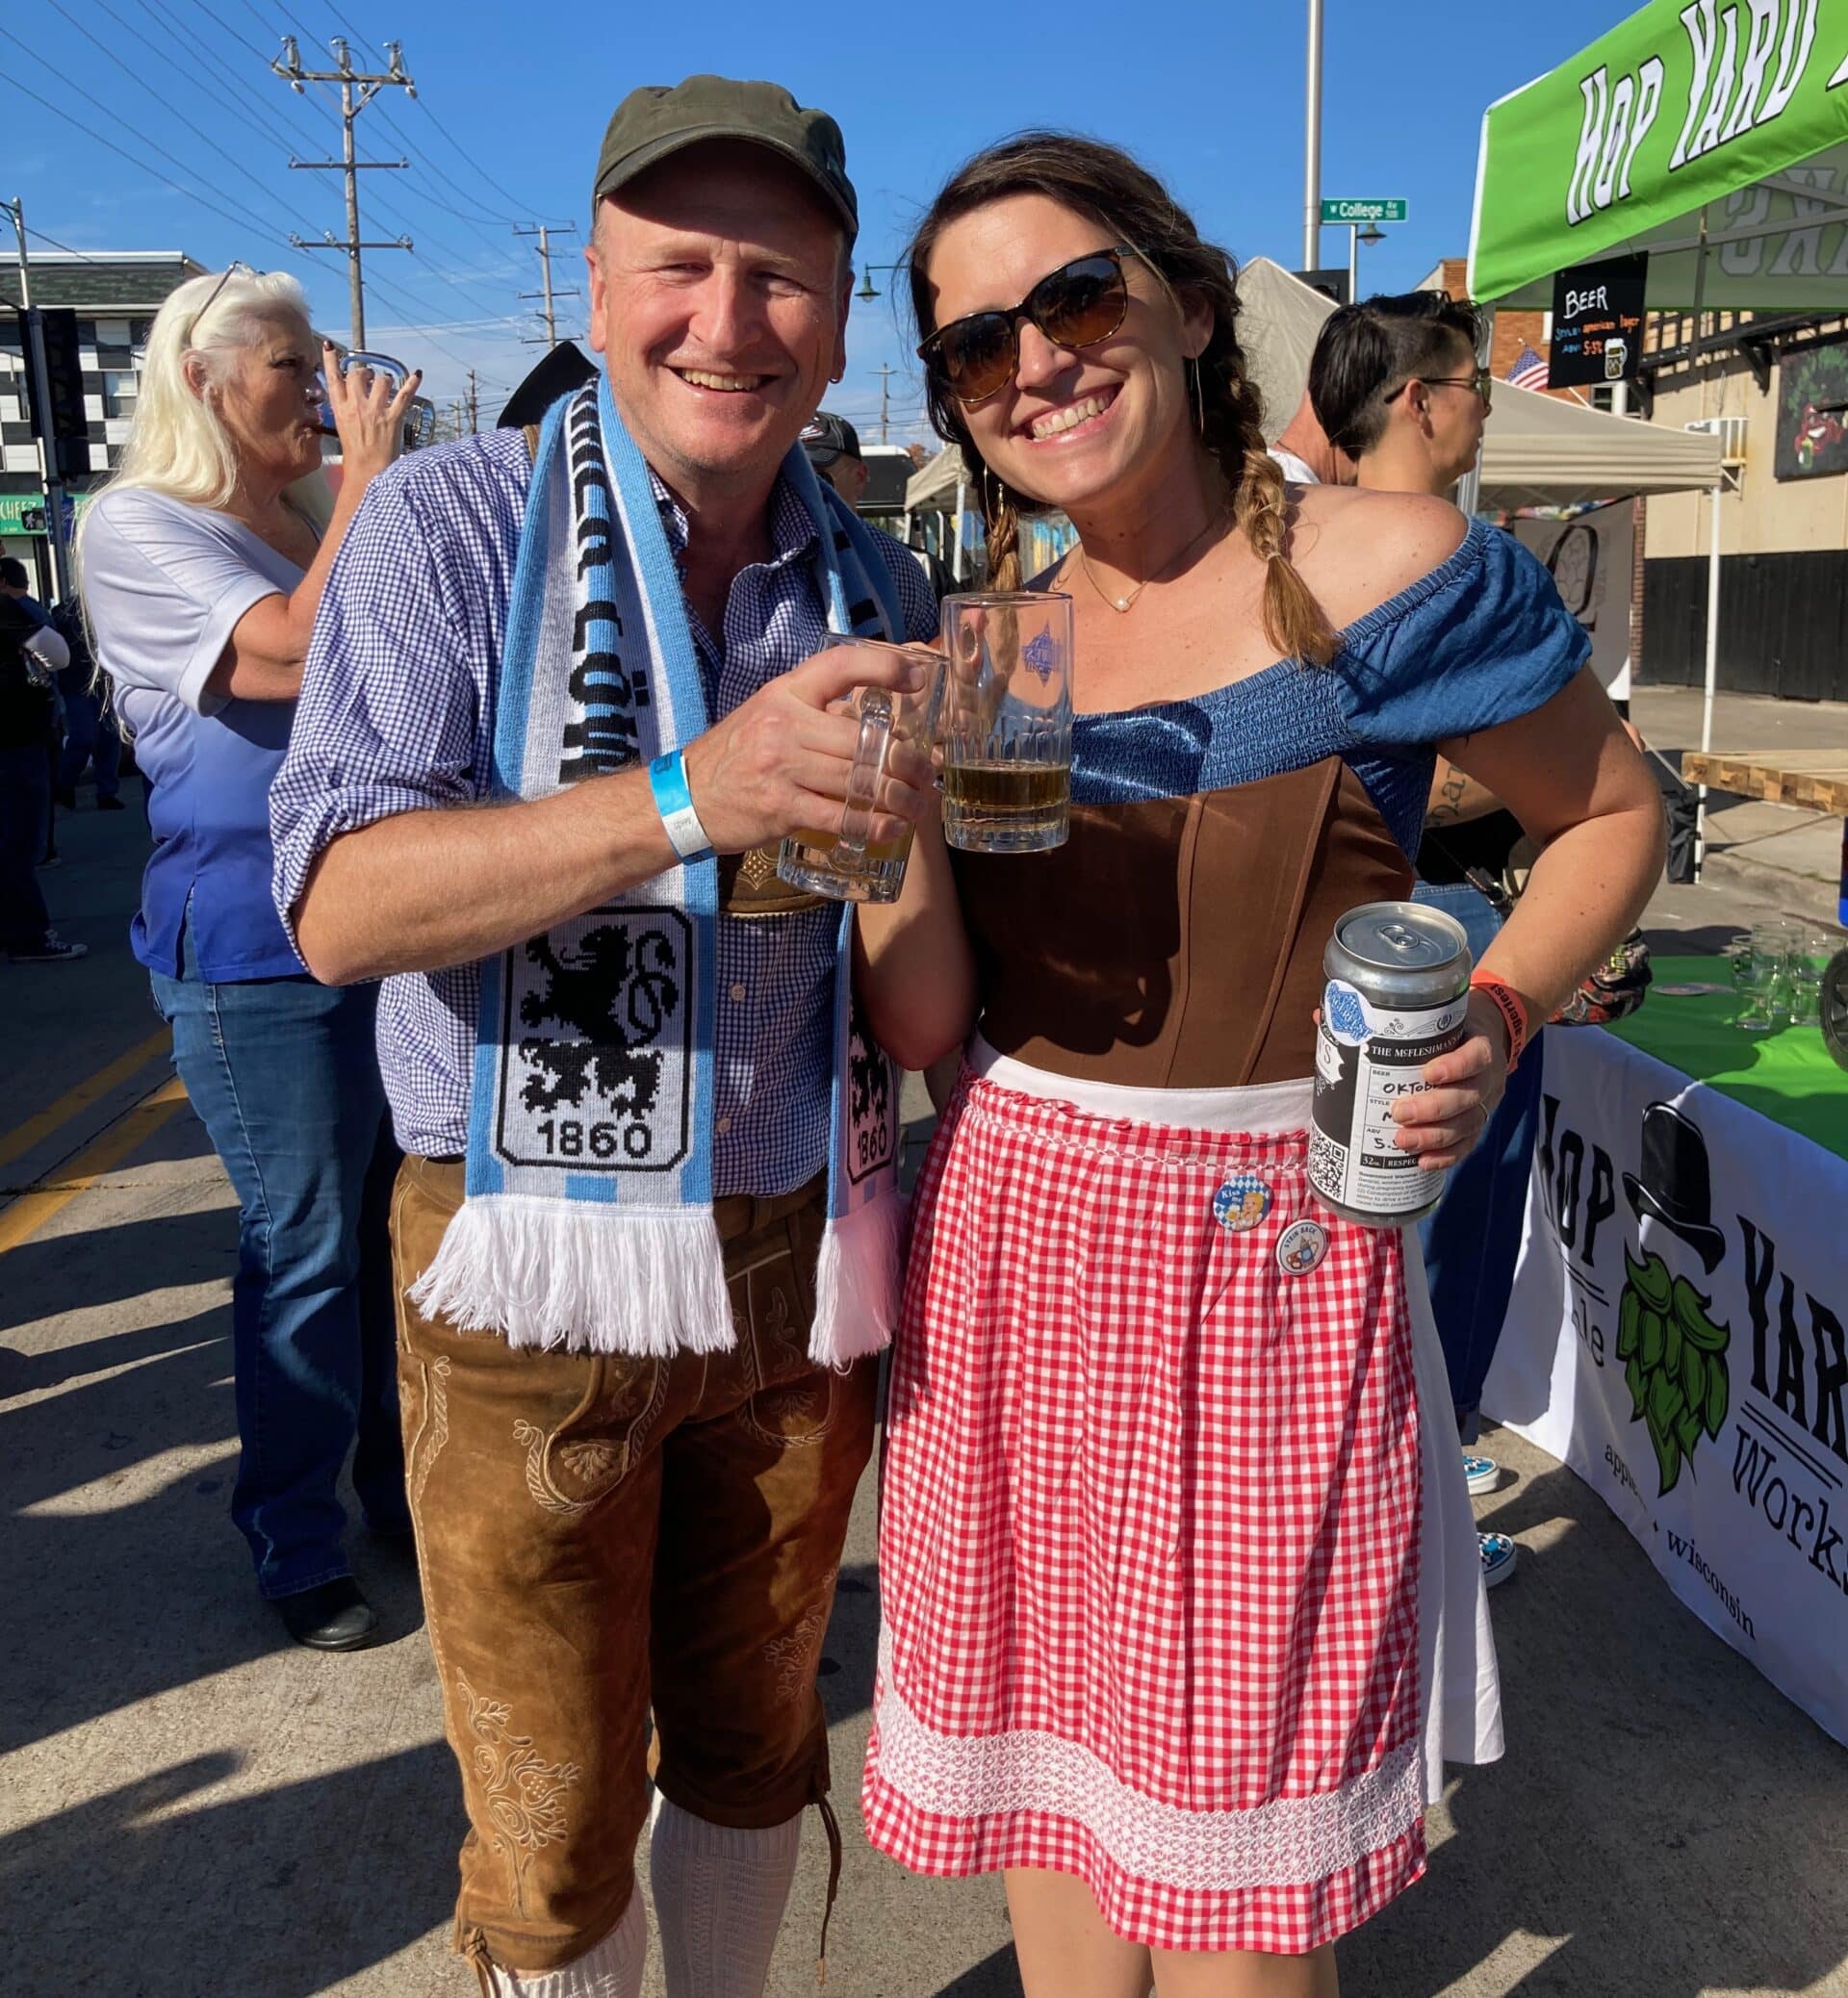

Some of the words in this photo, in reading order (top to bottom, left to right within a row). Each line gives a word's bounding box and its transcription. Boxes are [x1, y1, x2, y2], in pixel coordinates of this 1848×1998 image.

[1565, 54, 1665, 227] HOP
[1668, 0, 1821, 173] YARD
[1339, 202, 1384, 219] College
[1563, 285, 1608, 319] BEER
[1372, 1045, 1392, 1057] THE
[537, 1119, 653, 1159] 1860
[857, 1121, 887, 1168] 1860
[1388, 1157, 1418, 1166] RESPEC
[1284, 1230, 1299, 1248] STEIN
[1300, 1226, 1318, 1235] BACK
[1735, 1214, 1848, 1465] YAR
[1733, 1424, 1848, 1597] Work
[1667, 1529, 1757, 1641] wisconsin
